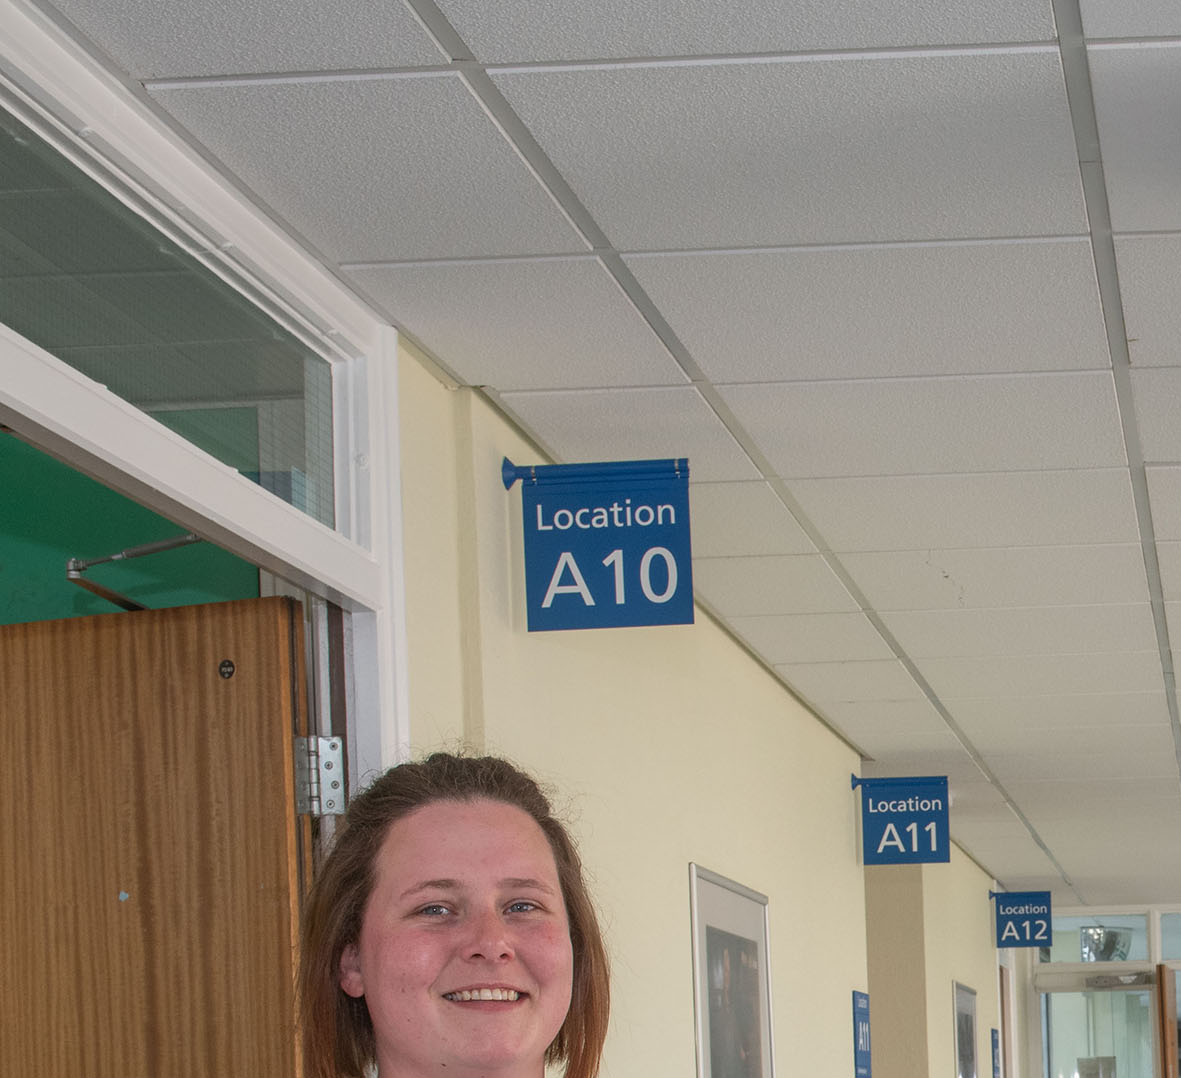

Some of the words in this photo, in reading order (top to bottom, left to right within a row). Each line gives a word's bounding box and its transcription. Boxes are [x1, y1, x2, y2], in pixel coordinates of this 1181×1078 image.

[536, 498, 676, 531] Location
[541, 546, 678, 609] A10
[868, 795, 942, 813] Location
[876, 821, 937, 854] A11
[999, 903, 1048, 915] Location
[1001, 919, 1048, 942] A12
